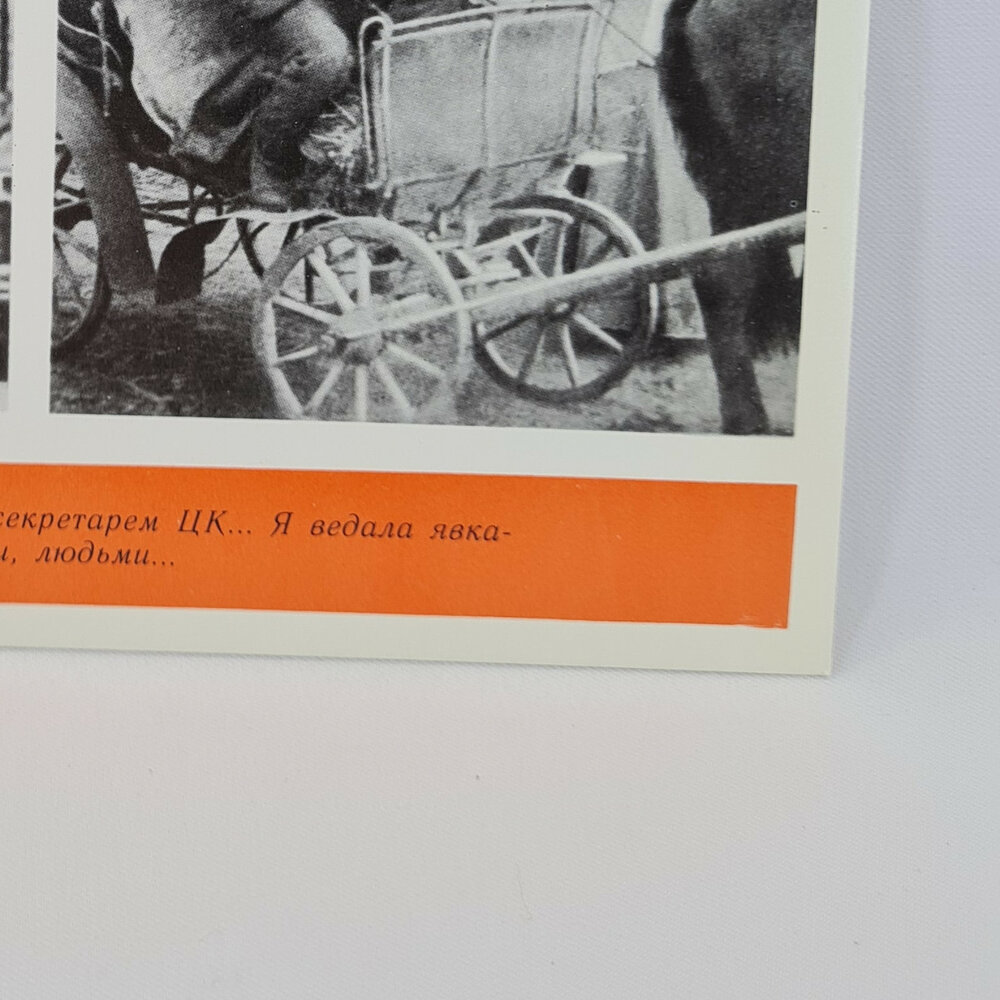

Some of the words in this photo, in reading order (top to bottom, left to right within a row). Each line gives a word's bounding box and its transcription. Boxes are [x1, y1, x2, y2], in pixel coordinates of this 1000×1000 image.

[269, 510, 294, 537] Я
[310, 513, 414, 540] ведала
[428, 522, 512, 542] явка-
[34, 540, 176, 567] людьми...
